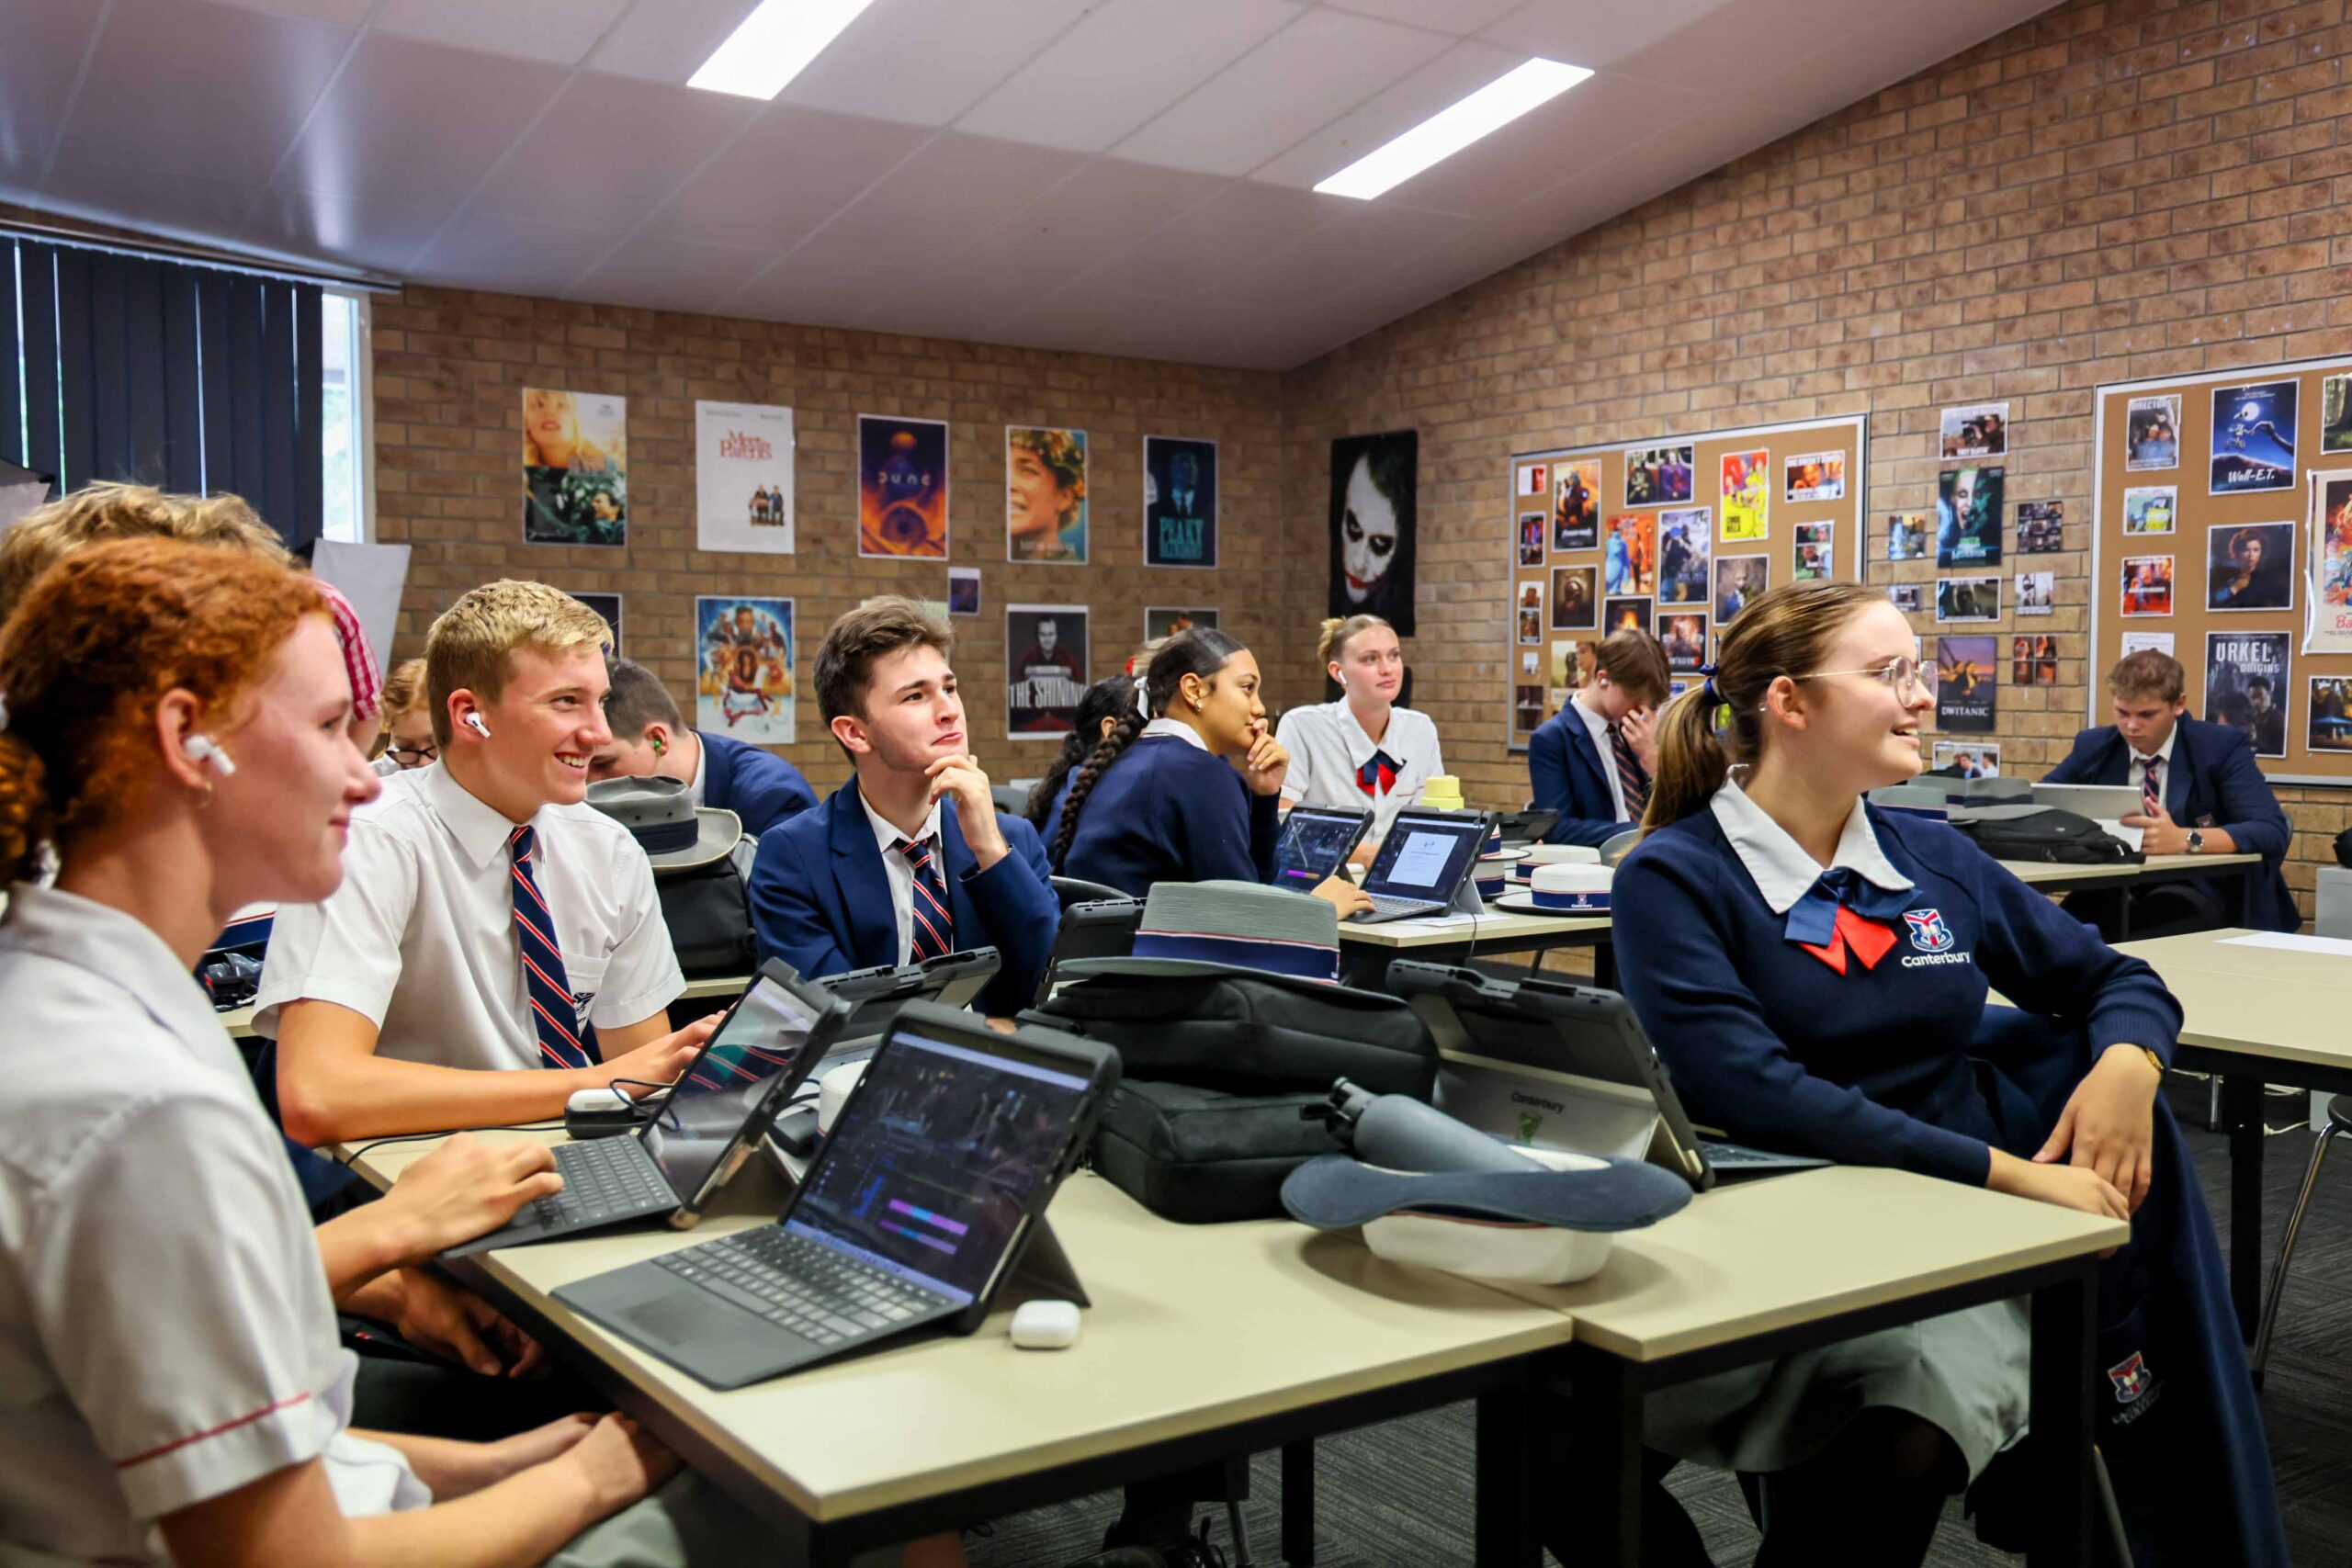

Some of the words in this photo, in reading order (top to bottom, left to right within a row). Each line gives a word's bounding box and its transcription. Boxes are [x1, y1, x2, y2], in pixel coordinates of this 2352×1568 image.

[2228, 468, 2276, 483] Wall-E.T.
[1159, 516, 1204, 546] PEAKY
[2216, 641, 2271, 662] URKEL
[2240, 662, 2280, 674] ORIGINS
[1009, 678, 1032, 708] THE
[1901, 952, 1971, 968] Canterbury
[1510, 1091, 1566, 1114] Canterbury
